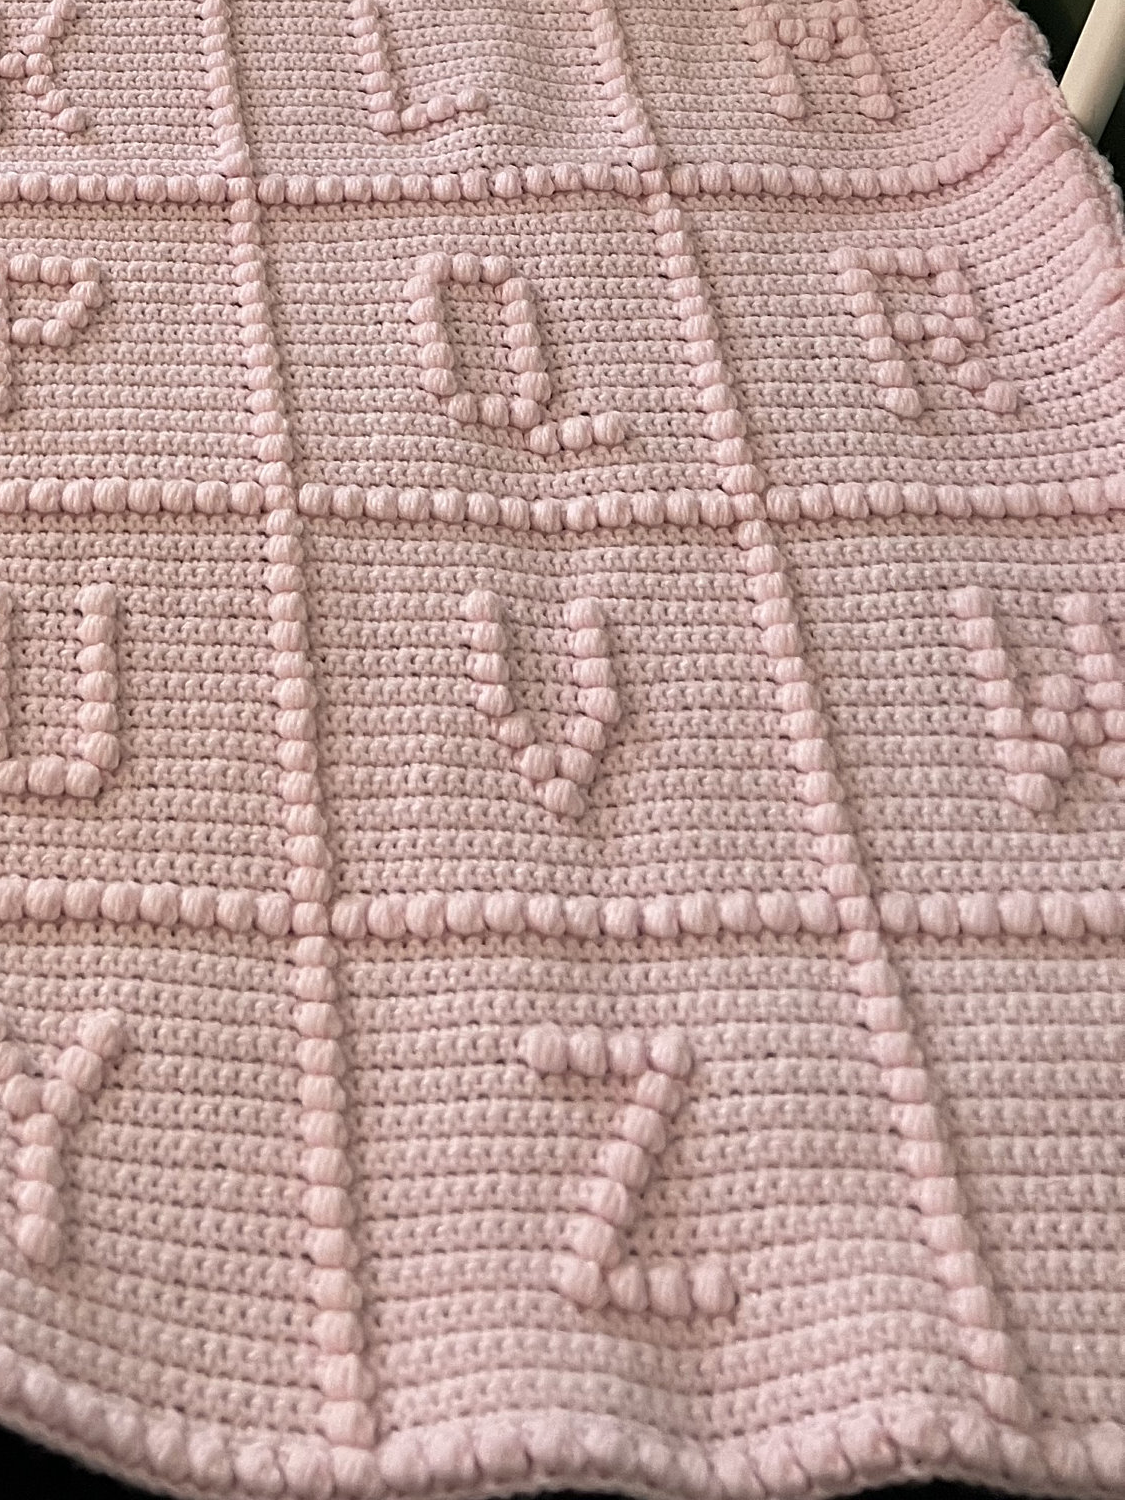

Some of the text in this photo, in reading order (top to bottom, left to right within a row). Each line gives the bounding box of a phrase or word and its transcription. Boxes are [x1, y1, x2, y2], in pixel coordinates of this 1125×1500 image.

[409, 251, 628, 457] Q
[830, 243, 1020, 420] R
[466, 586, 623, 820] V
[520, 1020, 738, 1320] Z
